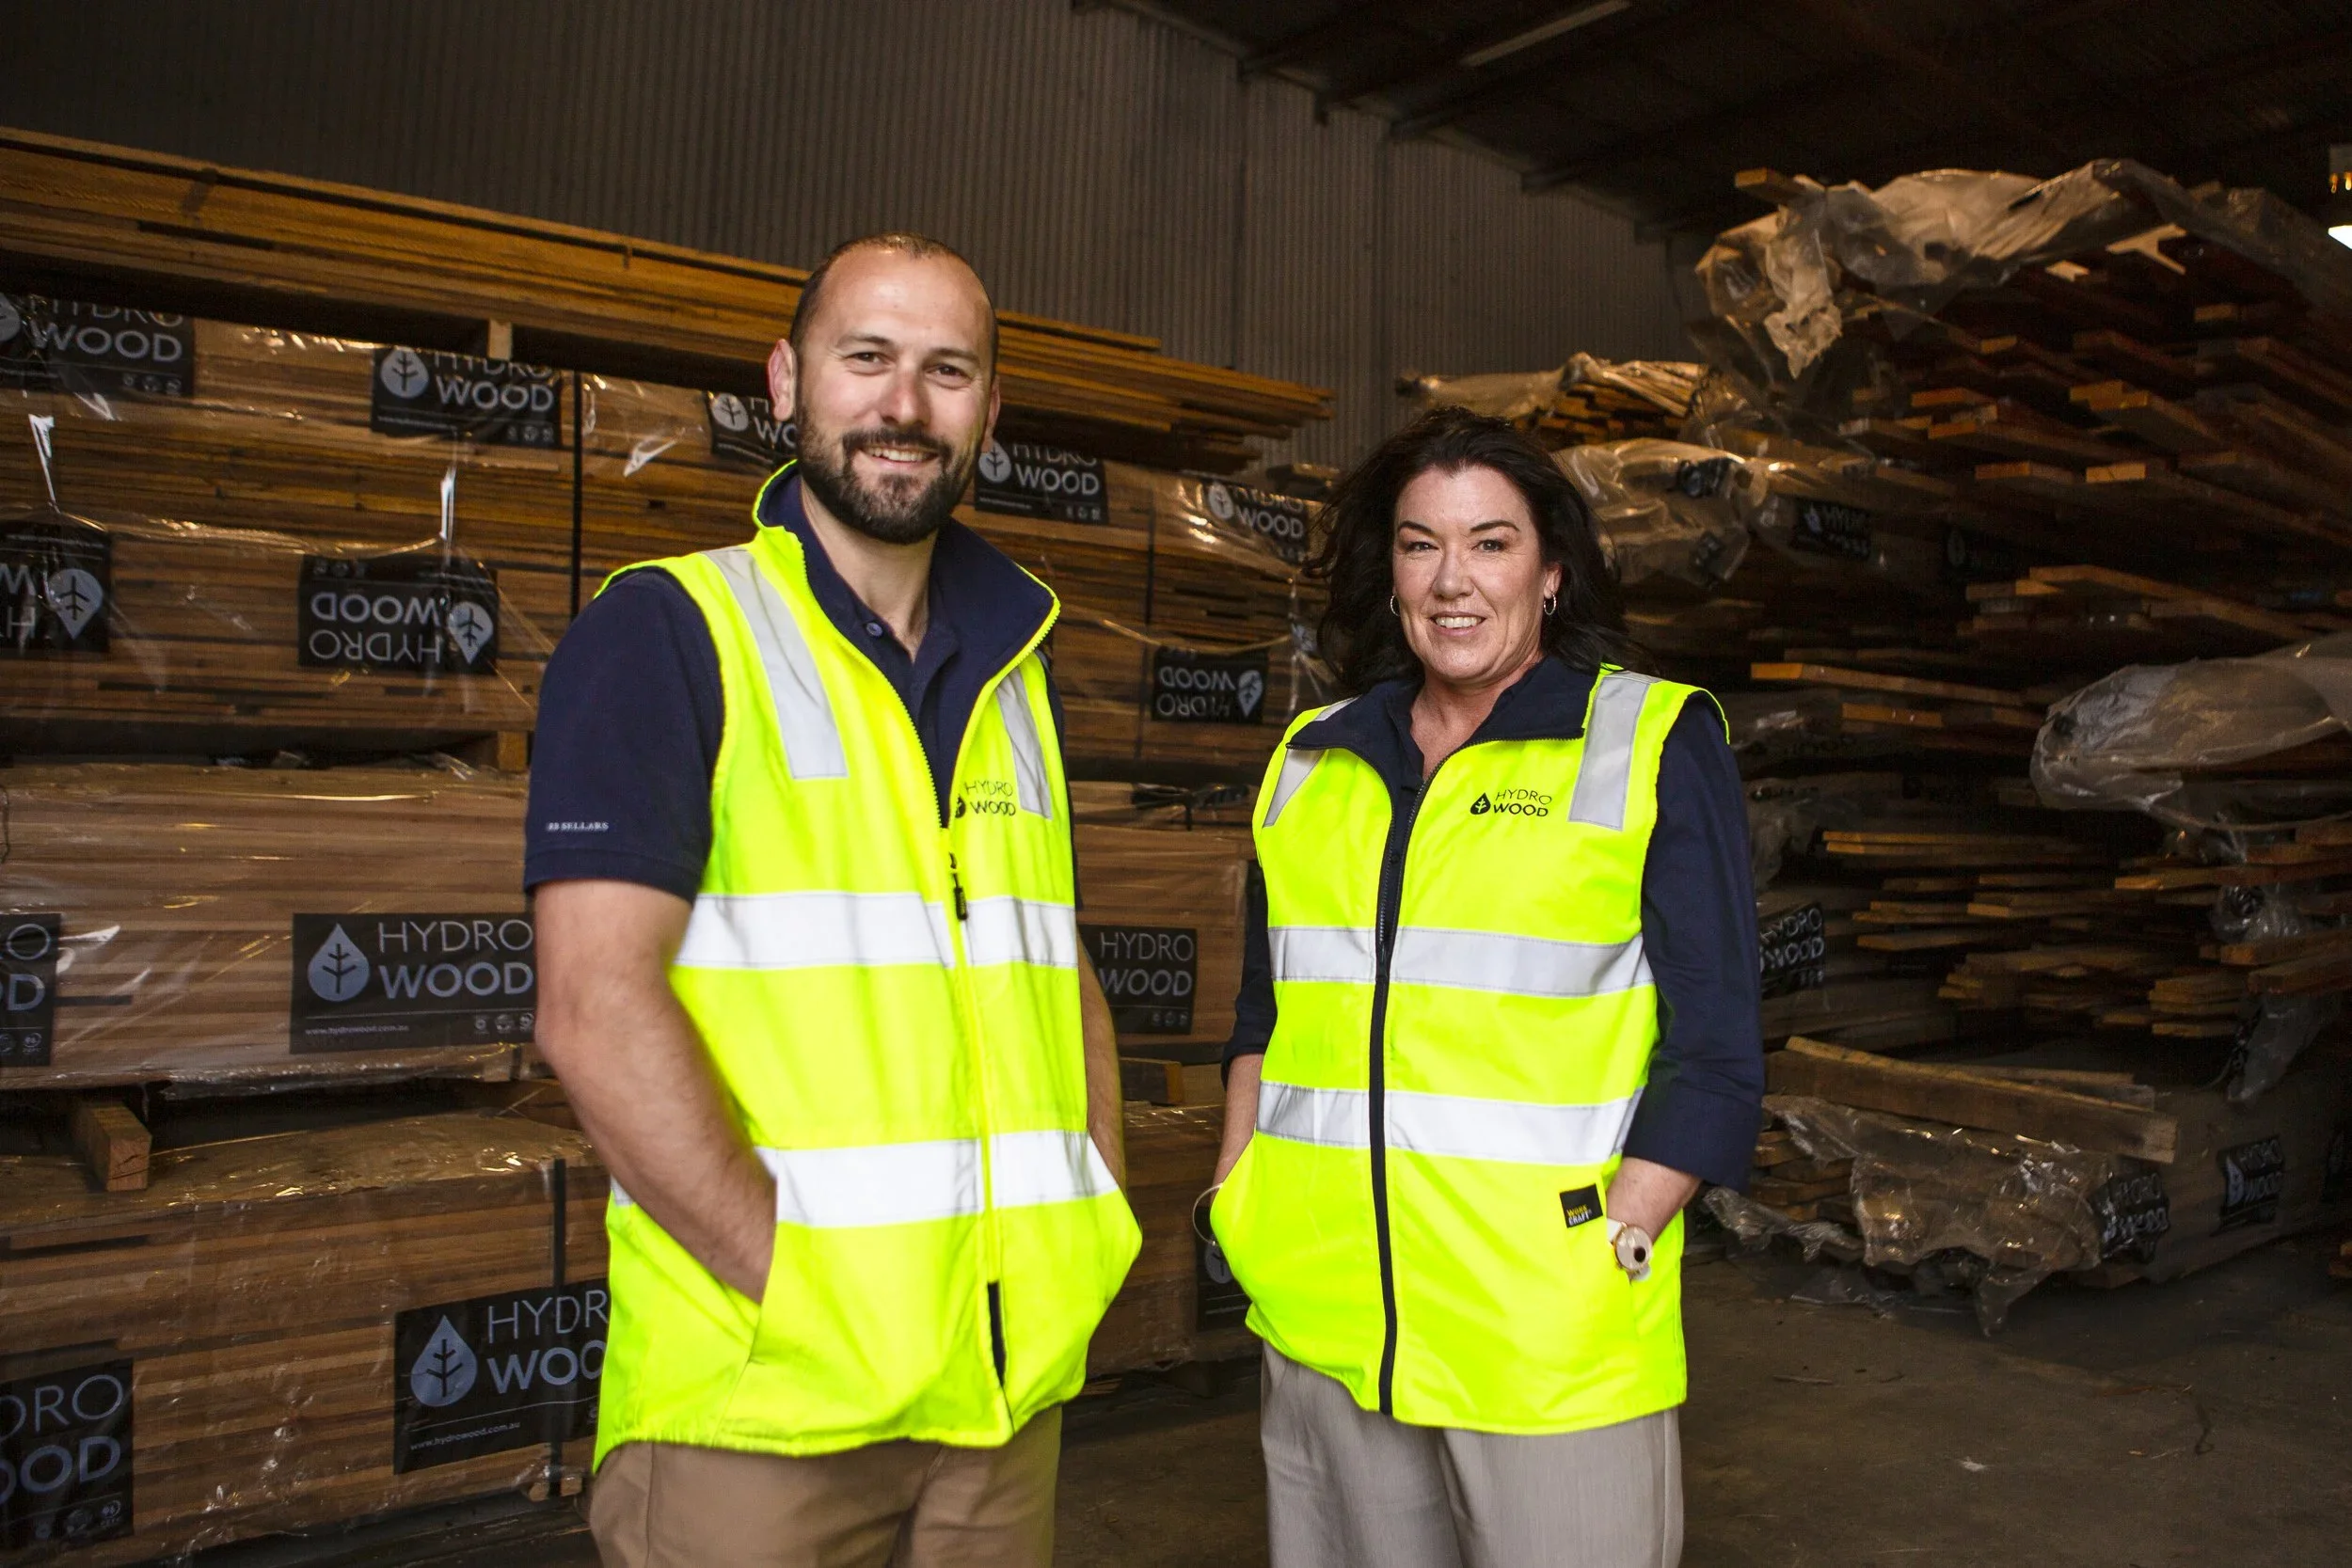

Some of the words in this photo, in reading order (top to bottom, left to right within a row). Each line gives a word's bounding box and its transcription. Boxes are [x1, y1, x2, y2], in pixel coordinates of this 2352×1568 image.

[29, 320, 183, 363] WOOD
[436, 376, 555, 412] WOOD
[754, 415, 798, 449] WO
[1015, 463, 1100, 496] WOOD
[1236, 504, 1304, 539] WOOD
[311, 592, 441, 626] WOOD
[309, 629, 440, 663] HYDRO
[1158, 665, 1236, 691] WOOD
[1156, 692, 1231, 718] HYDRO
[964, 780, 1014, 798] HYDRO
[1495, 788, 1552, 805] HYDRO
[970, 800, 1017, 816] WOOD
[1493, 802, 1549, 817] WOOD
[378, 919, 533, 953] HYDRO
[1759, 907, 1823, 945] HYDRO
[1100, 931, 1195, 962] HYDRO
[1765, 936, 1825, 970] WOOD
[378, 961, 534, 1000] WOOD
[1099, 968, 1193, 997] WOOD
[487, 1289, 610, 1344] HYDR
[486, 1339, 606, 1395] WOO
[0, 1374, 124, 1444] DRO
[409, 1421, 521, 1450] www.hydrowood.com.au
[0, 1435, 121, 1505] OD
